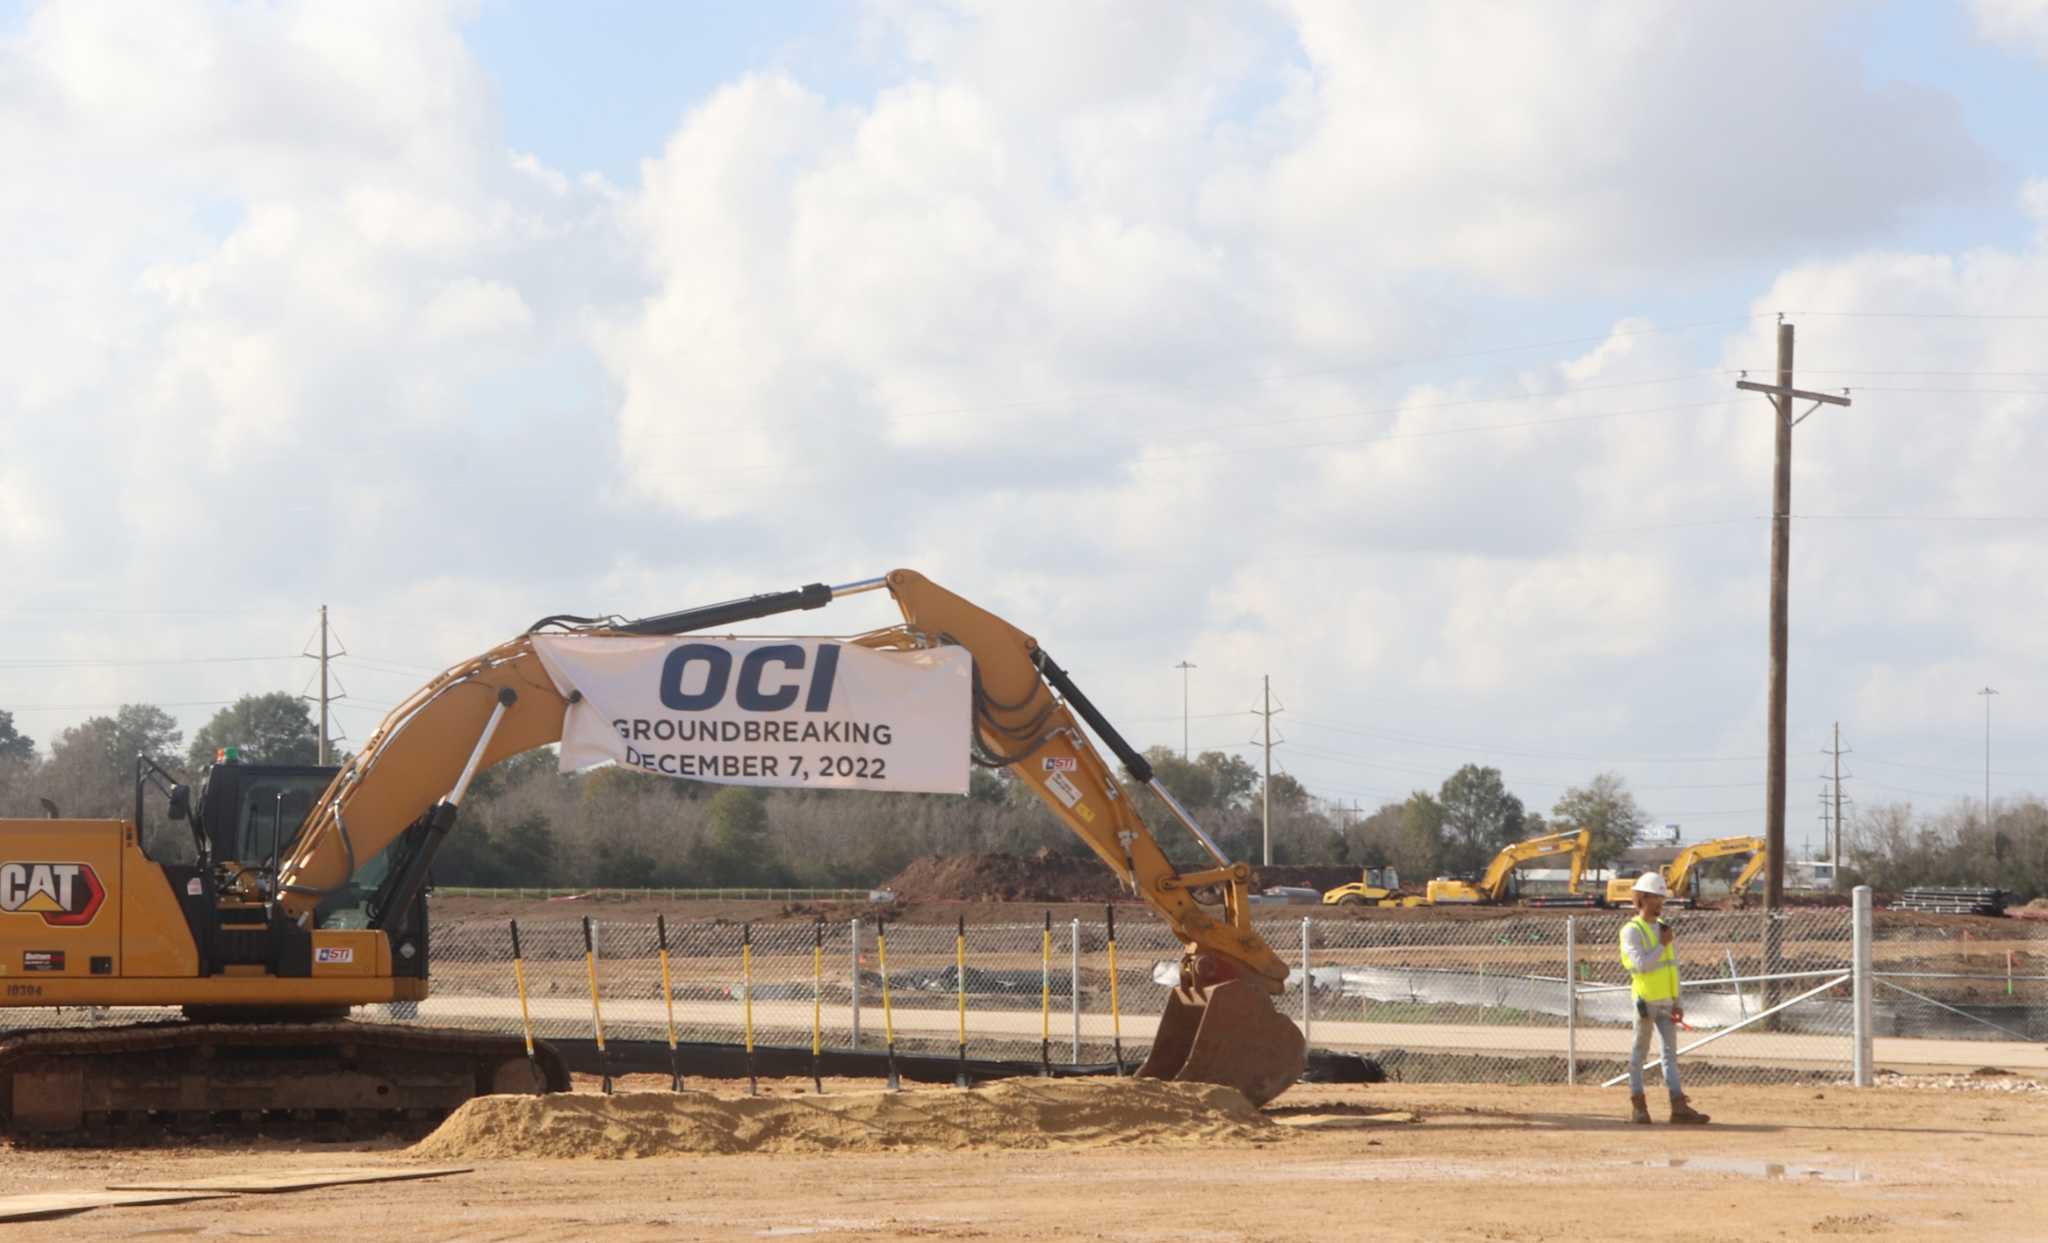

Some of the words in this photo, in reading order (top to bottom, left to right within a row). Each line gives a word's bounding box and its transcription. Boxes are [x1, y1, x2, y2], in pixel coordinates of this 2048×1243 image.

[659, 644, 841, 712] OCI
[613, 719, 891, 745] GROUNDBREAKING
[626, 745, 778, 776] DECEMBER
[789, 756, 808, 781] 7,
[819, 756, 885, 780] 2022
[0, 863, 79, 911] CAT
